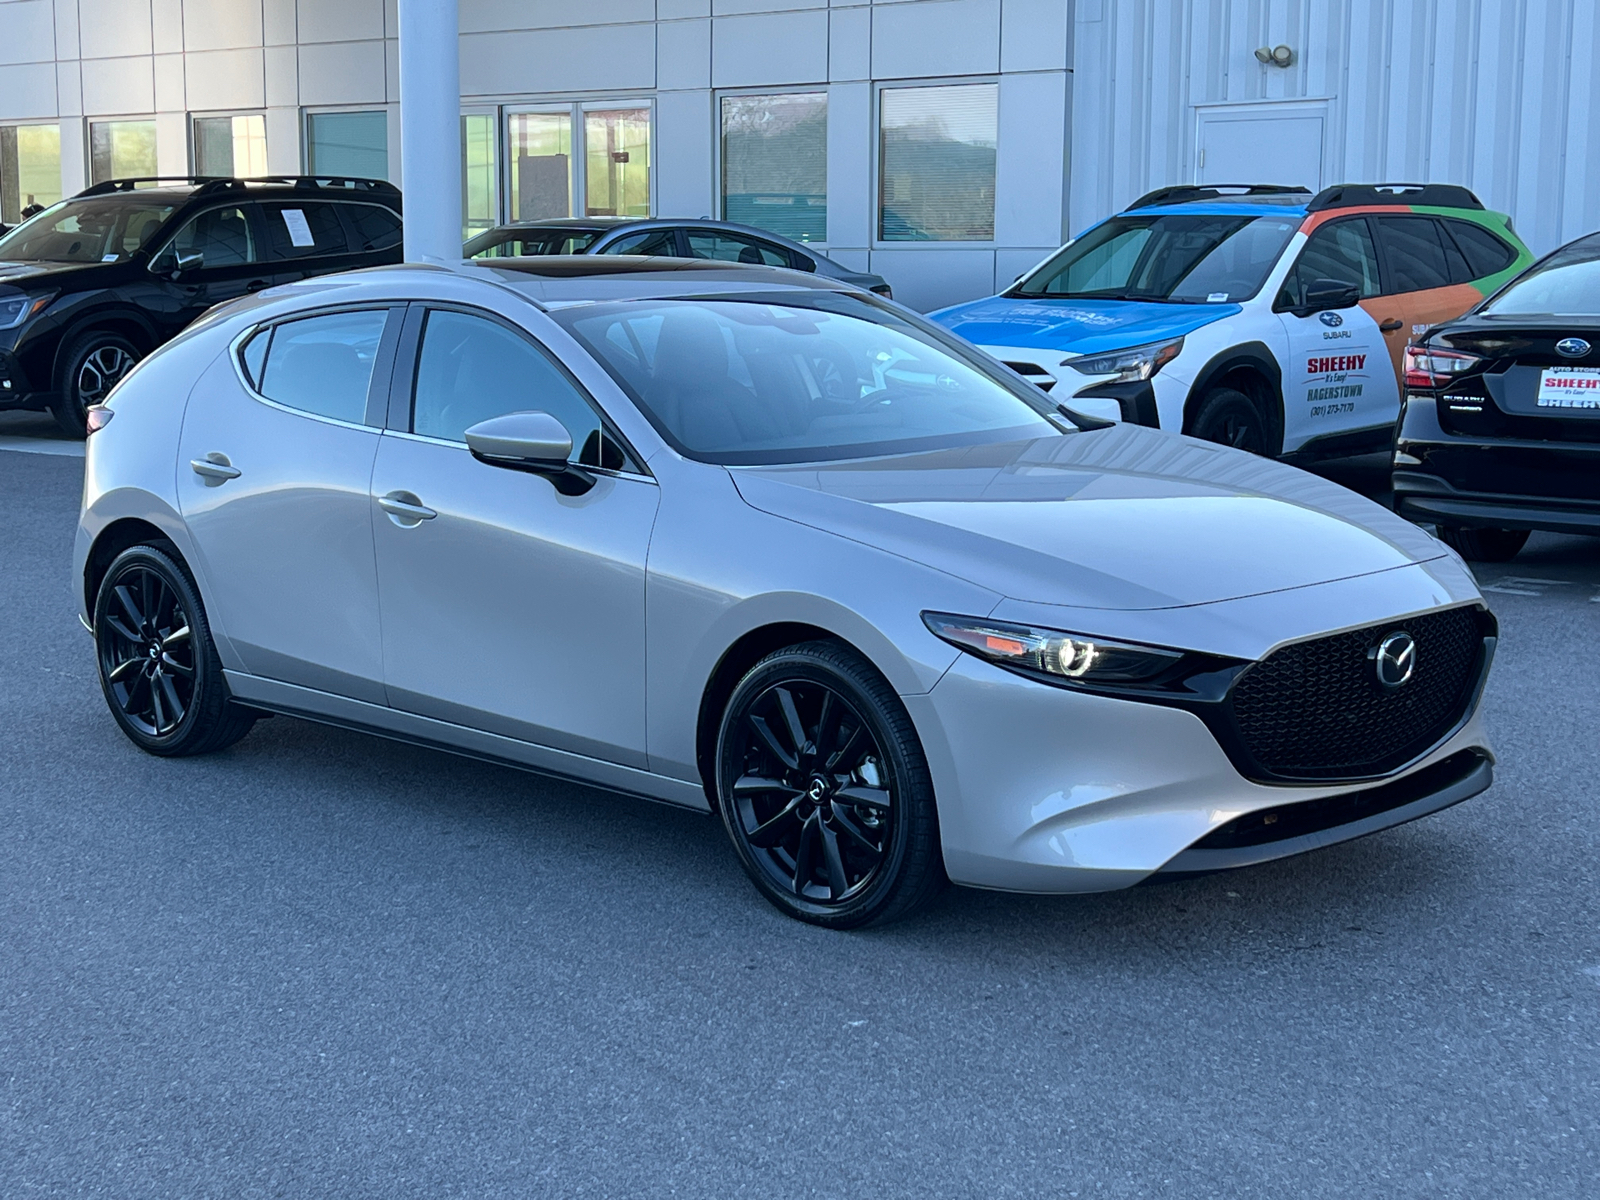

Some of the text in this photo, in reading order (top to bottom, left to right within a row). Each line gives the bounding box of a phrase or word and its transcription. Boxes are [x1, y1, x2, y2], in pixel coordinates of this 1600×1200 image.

[1323, 331, 1351, 340] SUBARU
[1308, 355, 1366, 373] SHEEHY
[1307, 385, 1363, 401] HAGERSTOWN
[1311, 403, 1354, 417] (301) 273-7170
